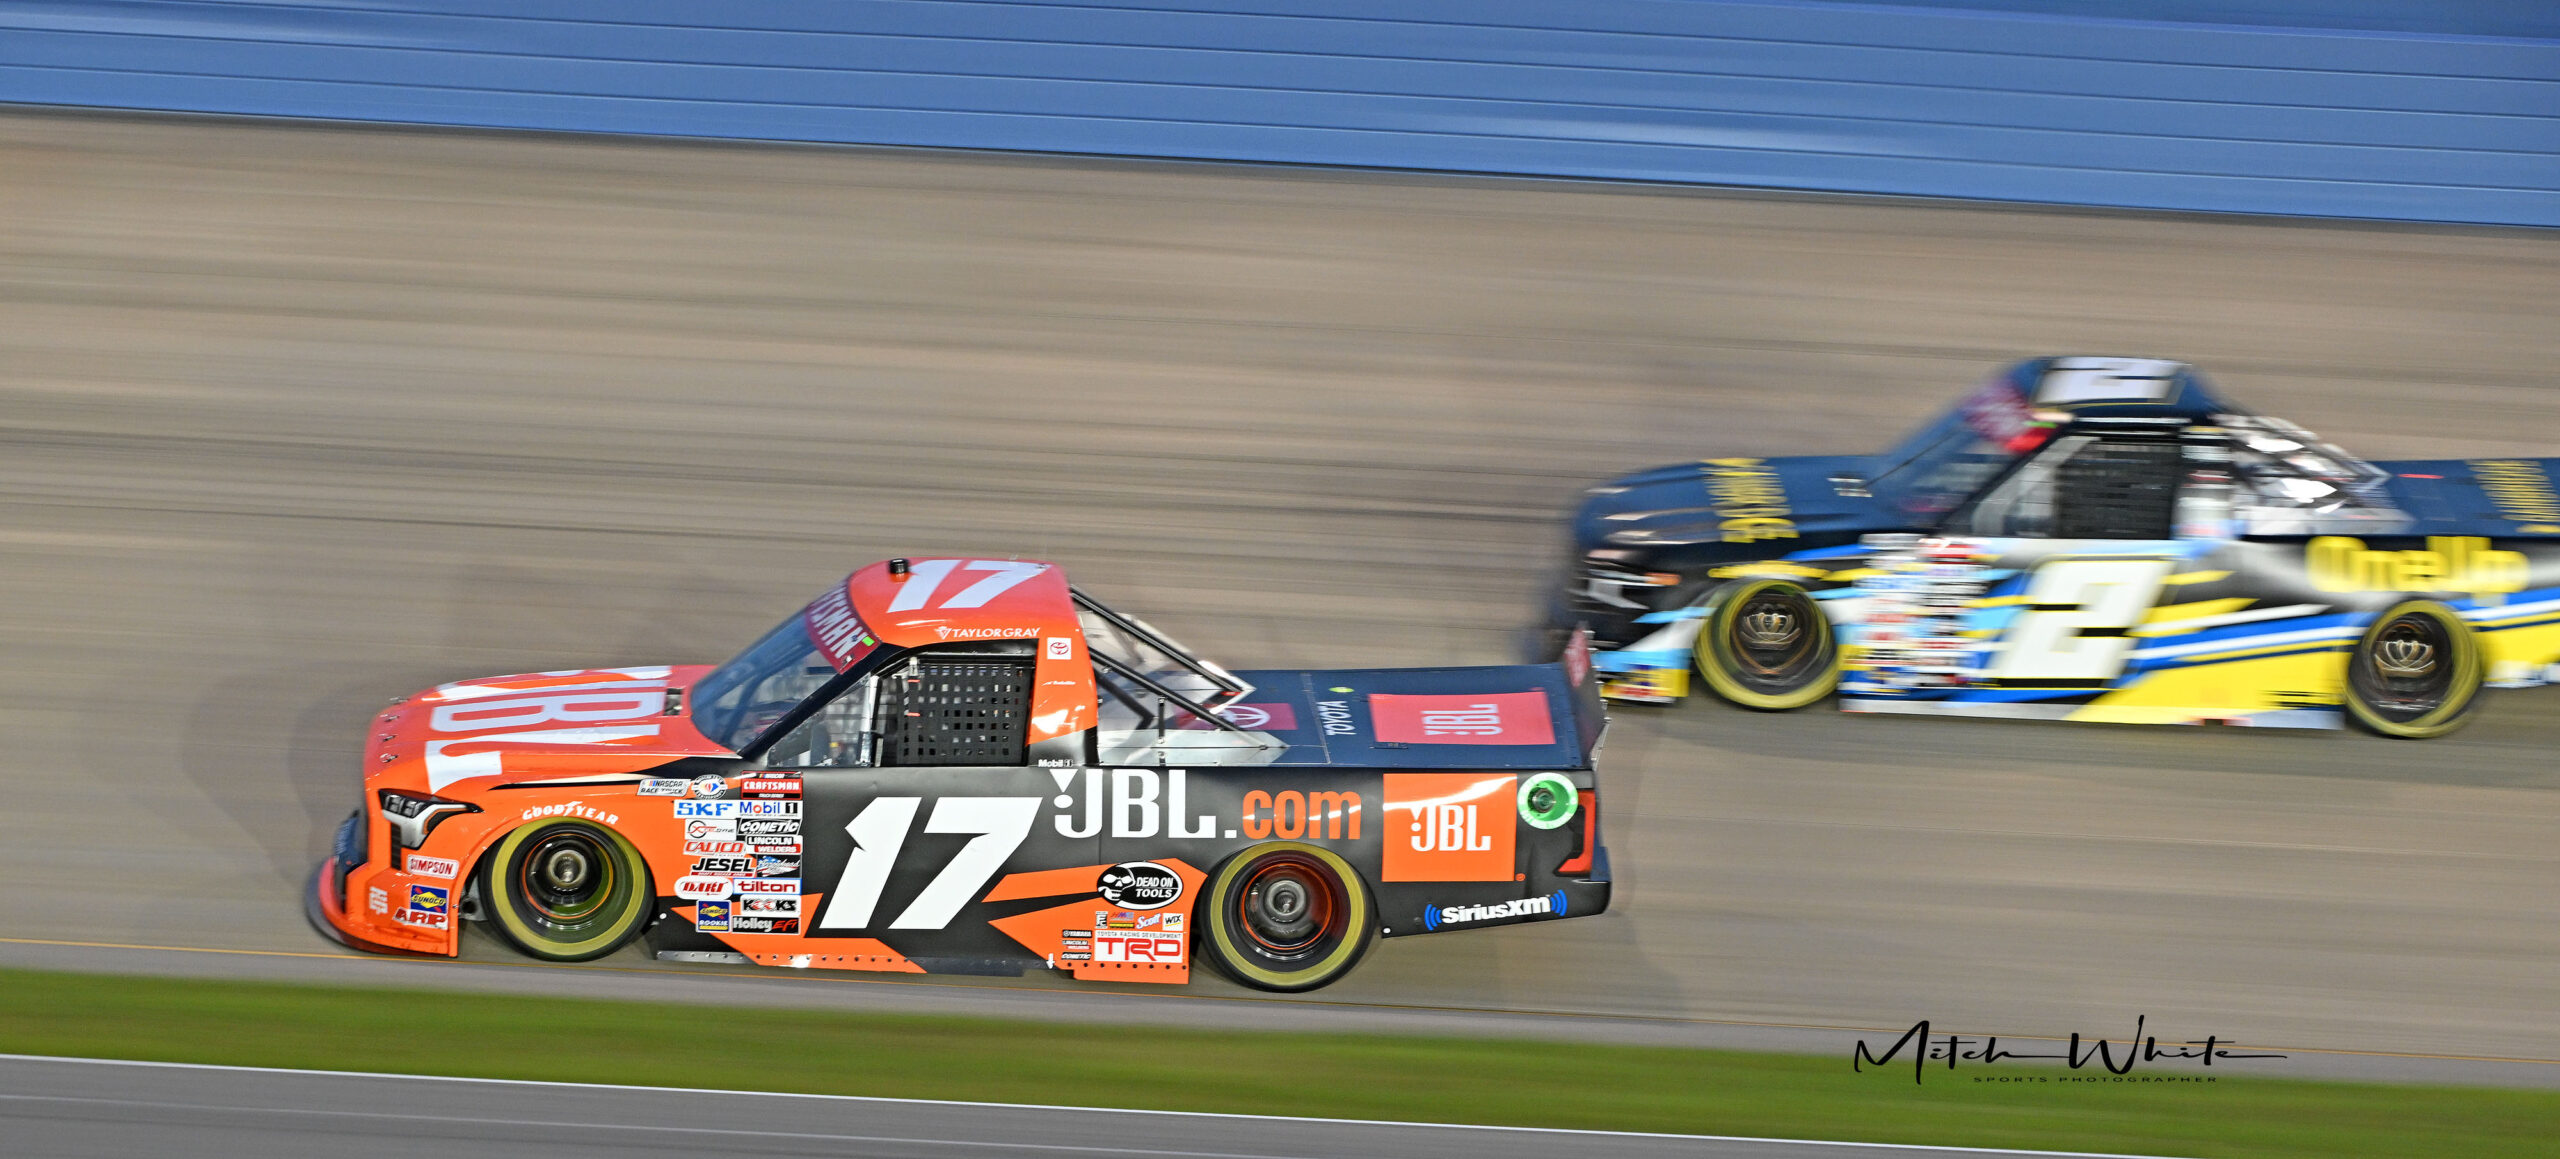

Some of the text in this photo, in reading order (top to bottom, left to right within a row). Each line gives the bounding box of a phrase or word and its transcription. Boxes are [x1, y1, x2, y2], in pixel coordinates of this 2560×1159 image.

[886, 559, 1052, 613] 17
[1992, 561, 2172, 678] 2
[952, 627, 1040, 638] TAYLOR GRAY
[1317, 700, 1357, 736] TOYOTA
[1421, 703, 1504, 736] JBL
[1038, 759, 1064, 768] Mobil
[743, 781, 800, 790] CRAFTSMAN
[522, 801, 619, 825] GOODYEAR
[677, 802, 733, 816] SKF
[740, 801, 799, 814] Mobil 1
[740, 821, 800, 832] COMETIC
[1409, 804, 1492, 852] JBL
[685, 841, 744, 853] CALICO
[748, 837, 793, 845] LINCOLN
[410, 859, 454, 875] SIMPSON
[692, 858, 754, 872] JESEL
[819, 797, 1043, 930] 17
[738, 881, 796, 892] tilton
[1136, 877, 1174, 888] DEAD ON
[412, 895, 446, 905] SUNOCO
[1136, 889, 1173, 898] TOOLS
[395, 908, 446, 926] ARP
[1165, 914, 1182, 924] WIX
[733, 917, 773, 932] Holley
[1097, 937, 1180, 961] TRD
